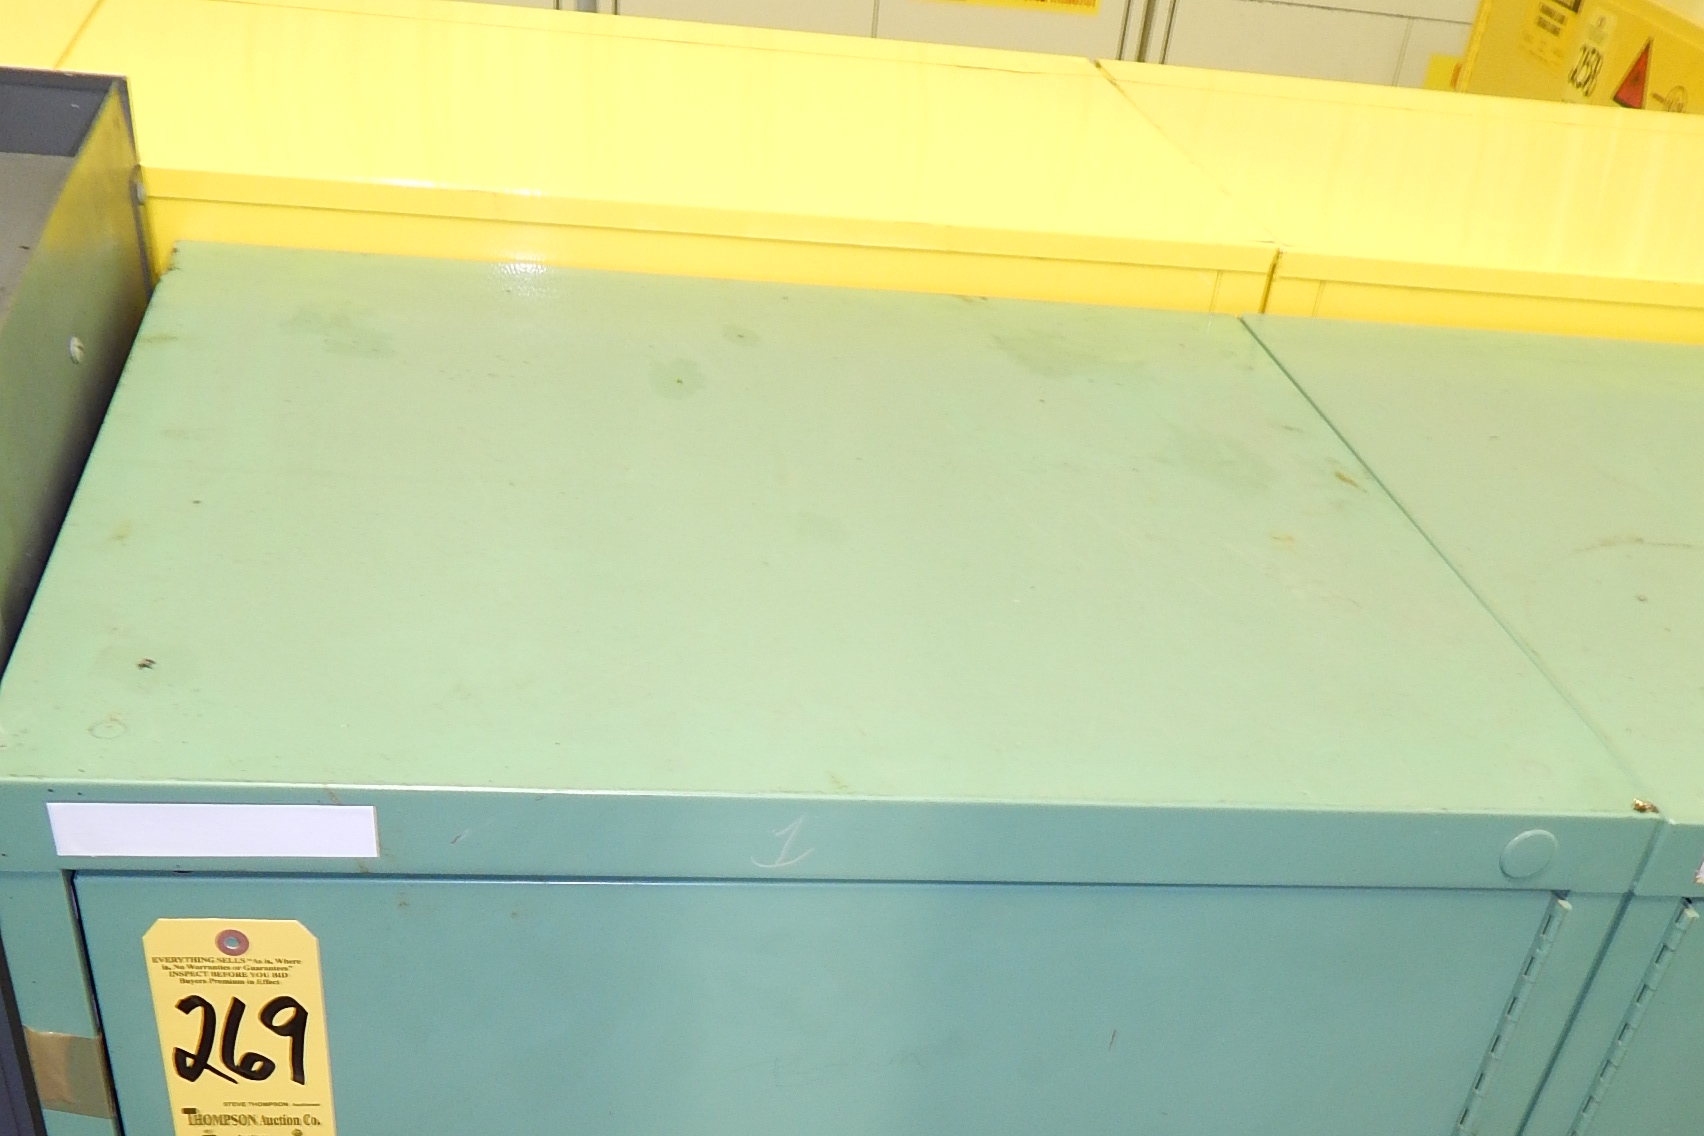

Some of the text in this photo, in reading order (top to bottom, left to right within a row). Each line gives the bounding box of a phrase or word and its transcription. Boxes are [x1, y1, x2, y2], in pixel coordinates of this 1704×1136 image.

[151, 956, 215, 964] EVERYTHING
[216, 956, 246, 964] SELLS
[275, 957, 302, 965] Where
[186, 963, 232, 972] Warranties
[168, 970, 208, 978] INSPECT
[210, 970, 248, 978] BEFORE
[249, 970, 271, 979] YOU
[172, 994, 309, 1086] 269
[185, 1110, 321, 1127] THOMPSON Auction Co.
